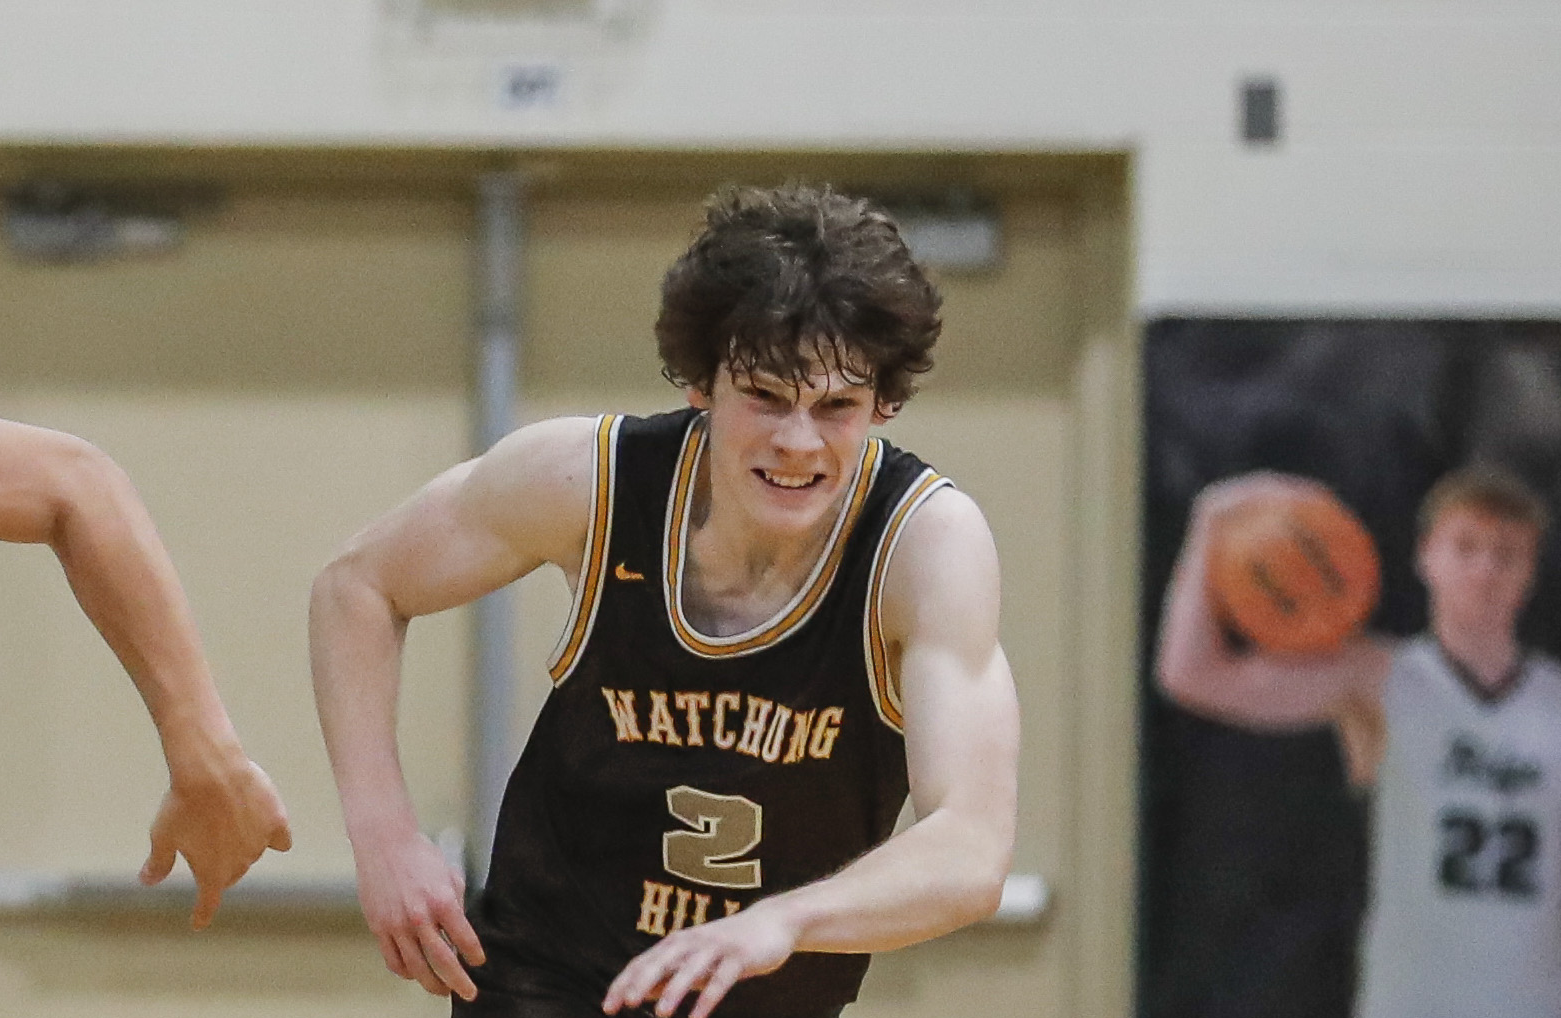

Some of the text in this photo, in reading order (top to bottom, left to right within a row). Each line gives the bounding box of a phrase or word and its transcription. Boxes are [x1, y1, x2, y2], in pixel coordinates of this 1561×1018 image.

[600, 686, 845, 764] WATCHUNG
[662, 785, 763, 889] 2
[1437, 812, 1541, 898] 22
[636, 880, 741, 937] HIL
